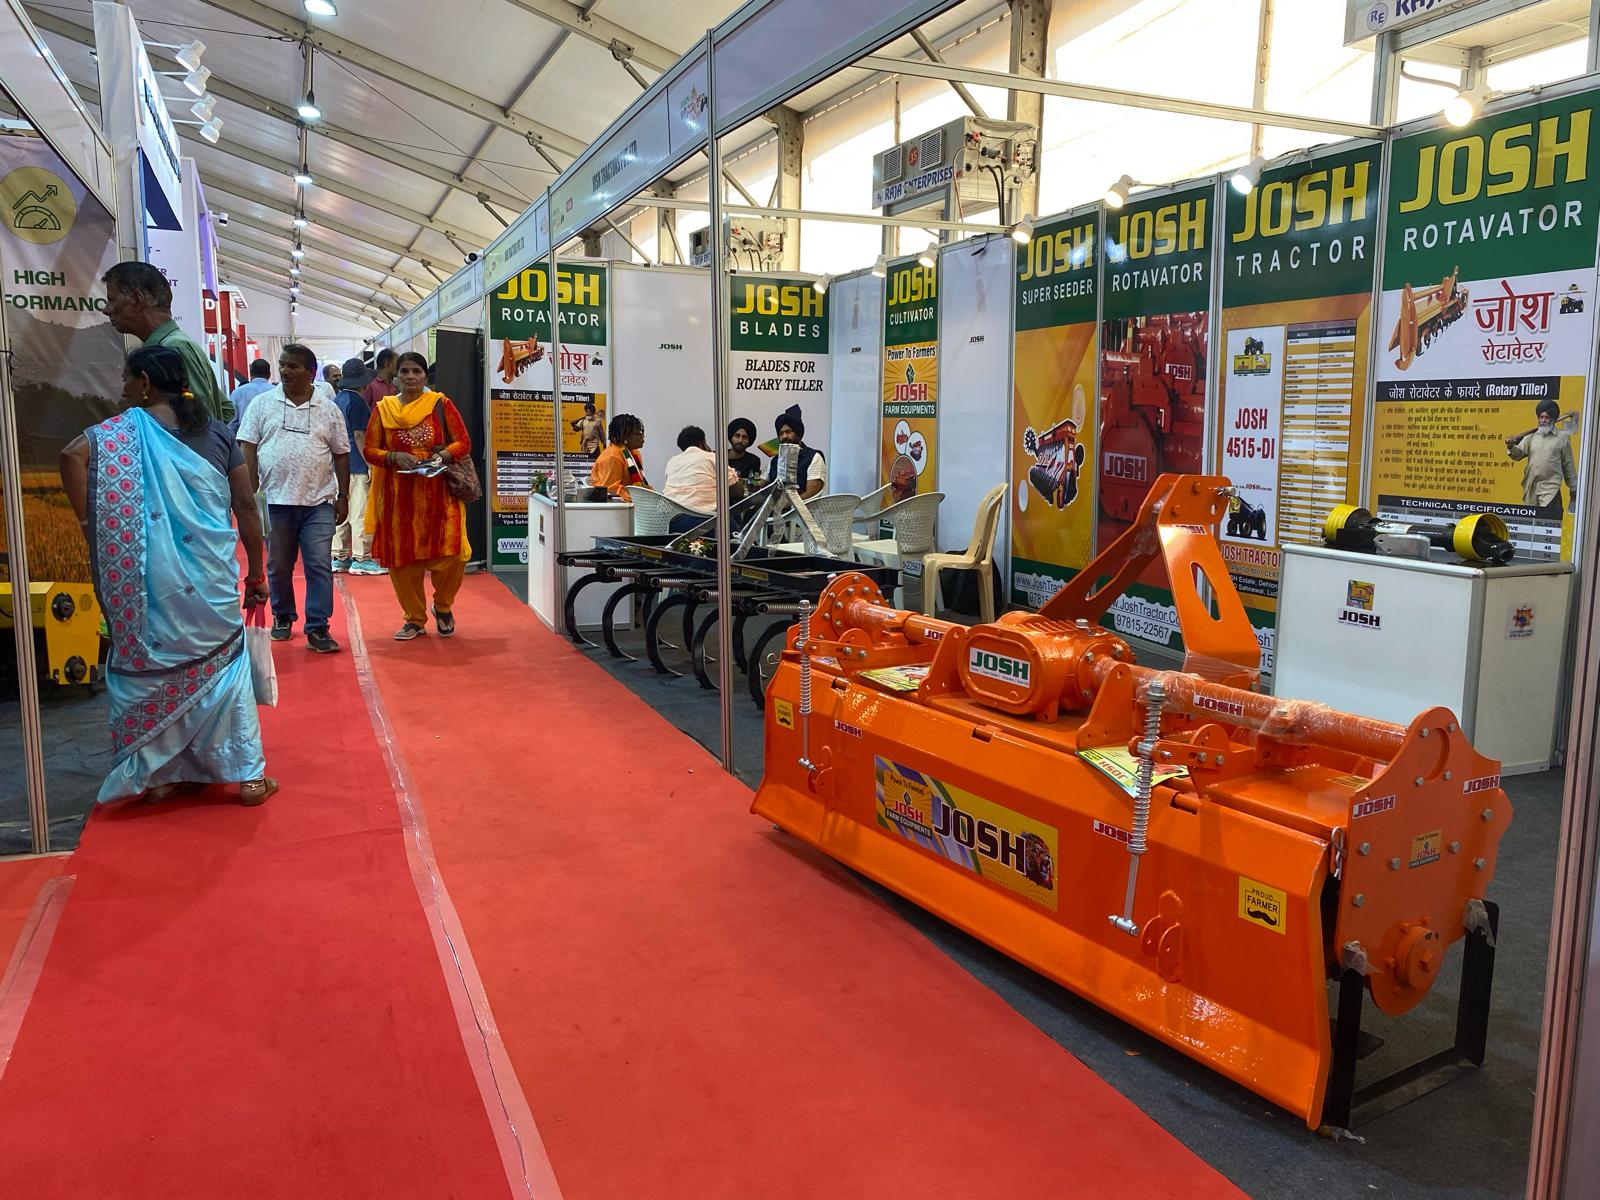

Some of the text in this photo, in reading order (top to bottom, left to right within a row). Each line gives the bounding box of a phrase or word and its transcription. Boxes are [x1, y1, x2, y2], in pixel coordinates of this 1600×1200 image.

[1399, 108, 1592, 213] JOSH
[884, 184, 902, 200] RAJA
[1232, 160, 1370, 243] JOSH
[1112, 198, 1207, 263] JOSH
[1403, 200, 1583, 252] ROTAVATOR
[1020, 223, 1094, 282] JOSH
[1236, 235, 1365, 277] TRACTOR
[14, 269, 66, 287] HIGH
[498, 269, 599, 306] JOSH
[889, 266, 937, 306] JOSH
[1112, 262, 1203, 292] ROTAVATOR
[736, 283, 824, 318] JOSH
[1022, 278, 1093, 305] SUPER SEEDER
[889, 307, 934, 325] CULTIVATOR
[1473, 280, 1555, 333] जोश
[740, 321, 820, 338] BLADES
[969, 335, 985, 343] JOSH
[887, 349, 904, 360] Power
[912, 346, 936, 358] Farmers
[1481, 337, 1545, 361] रोटावेटर
[745, 359, 816, 373] BLADES FOR
[561, 373, 587, 385] टावेटर
[736, 378, 824, 392] ROTARY TILLER
[893, 384, 928, 401] JOSH
[1389, 382, 1548, 399] जोश रोटावेटर के फायदे (Rotary Tiller)
[885, 404, 935, 414] FARM EQUIPMENTS
[1235, 408, 1268, 429] JOSH
[1227, 437, 1275, 460] 4515-DI
[1105, 455, 1146, 480] JOSH
[1401, 499, 1536, 516] TECHNICAL SPECIFICATION
[1116, 614, 1169, 640] 97815-22567
[1339, 611, 1381, 626] JOSH
[971, 651, 1029, 680] JOSH
[1194, 697, 1242, 716] JOSH
[835, 721, 862, 737] JOSH
[1464, 777, 1499, 793] JOSH
[895, 800, 923, 824] JOSH
[1354, 797, 1395, 818] JOSH
[886, 810, 931, 836] FARM EQUIPMENTS
[934, 803, 1026, 875] JOSH
[1247, 895, 1278, 914] FARMER
[1252, 889, 1273, 901] PROUD
